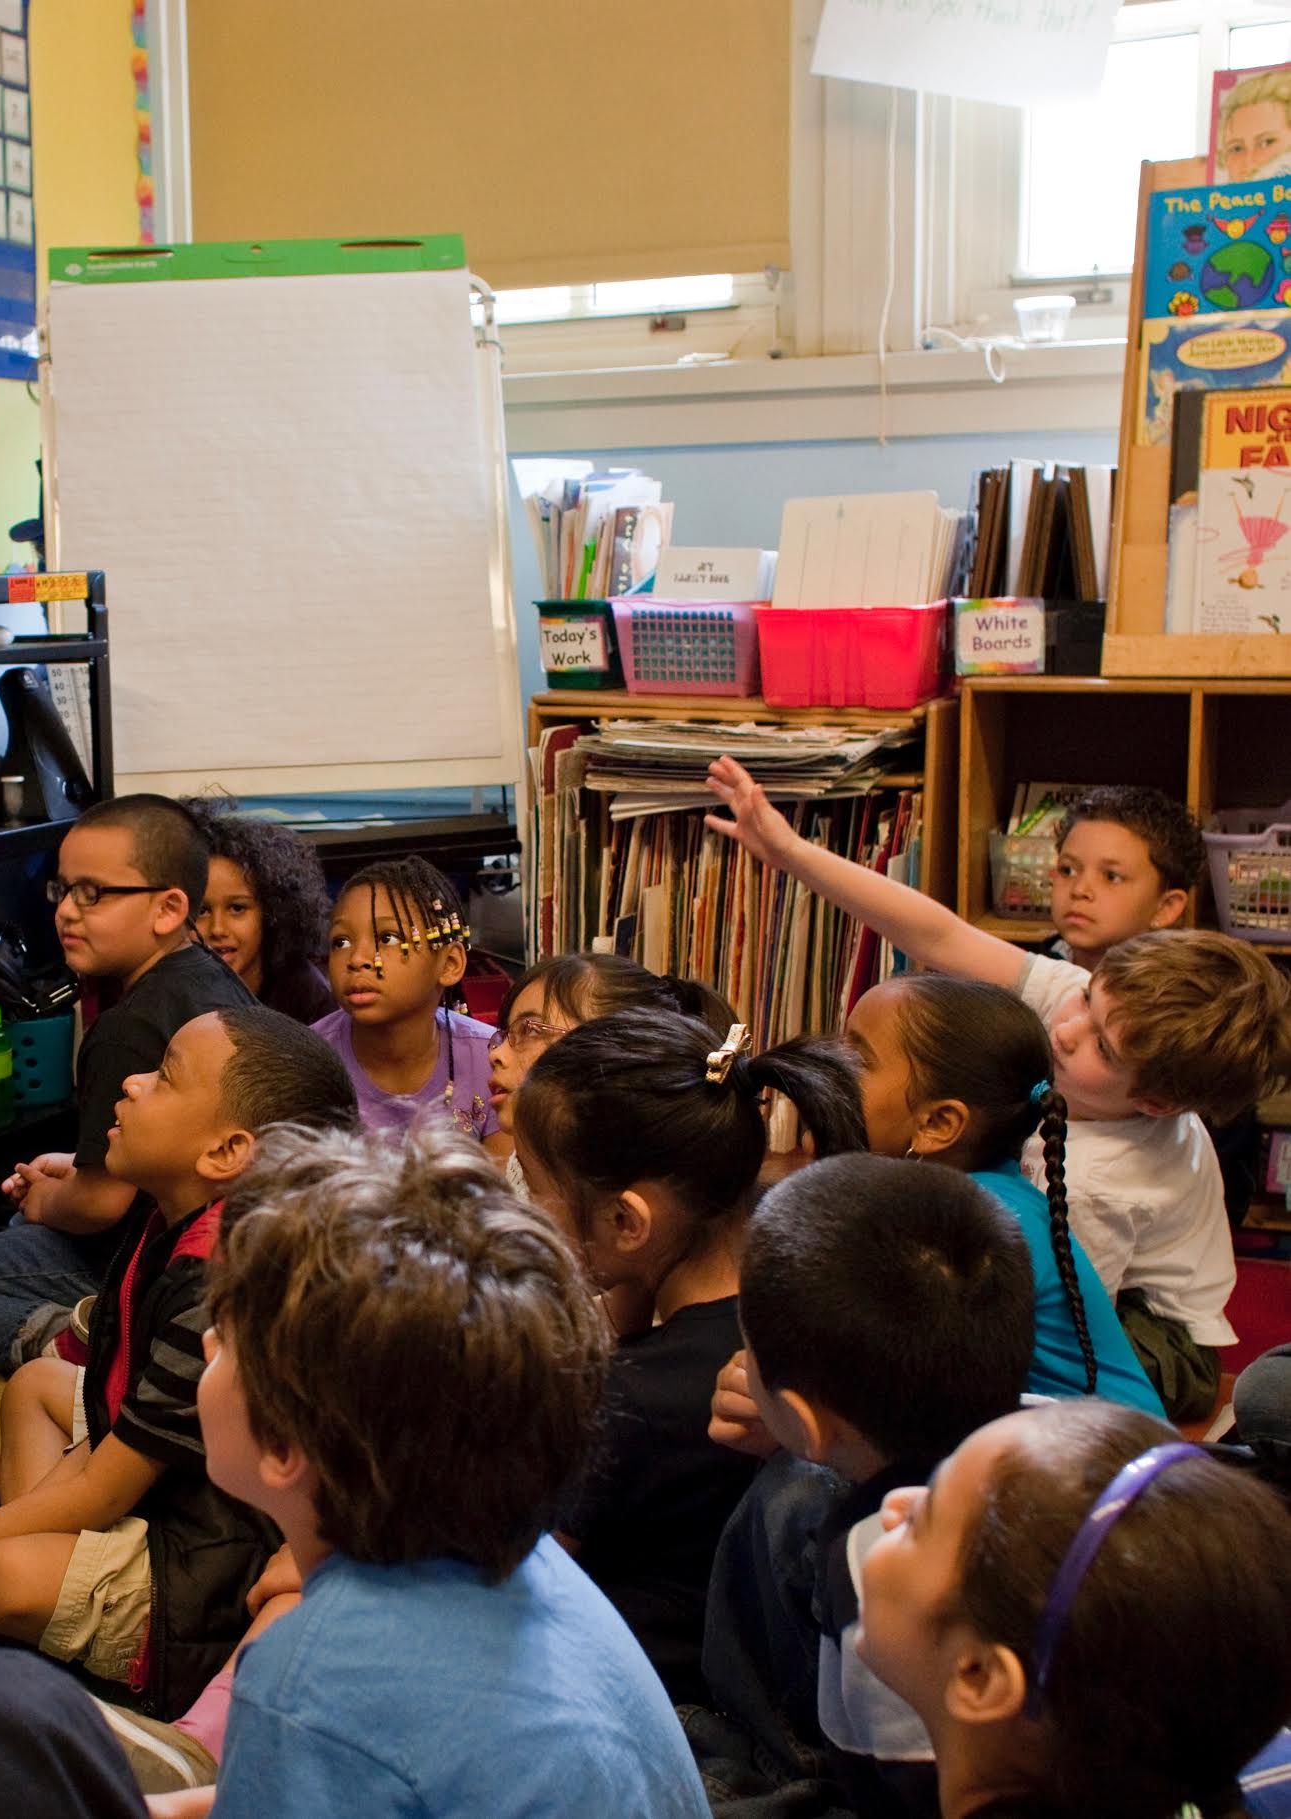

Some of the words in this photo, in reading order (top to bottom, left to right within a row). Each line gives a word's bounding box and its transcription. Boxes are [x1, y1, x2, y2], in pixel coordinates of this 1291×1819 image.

[1165, 197, 1202, 214] The
[1209, 191, 1267, 211] Peace
[975, 616, 1029, 631] White
[543, 627, 598, 646] Today's
[972, 634, 1032, 652] Boards
[551, 651, 592, 666] Work
